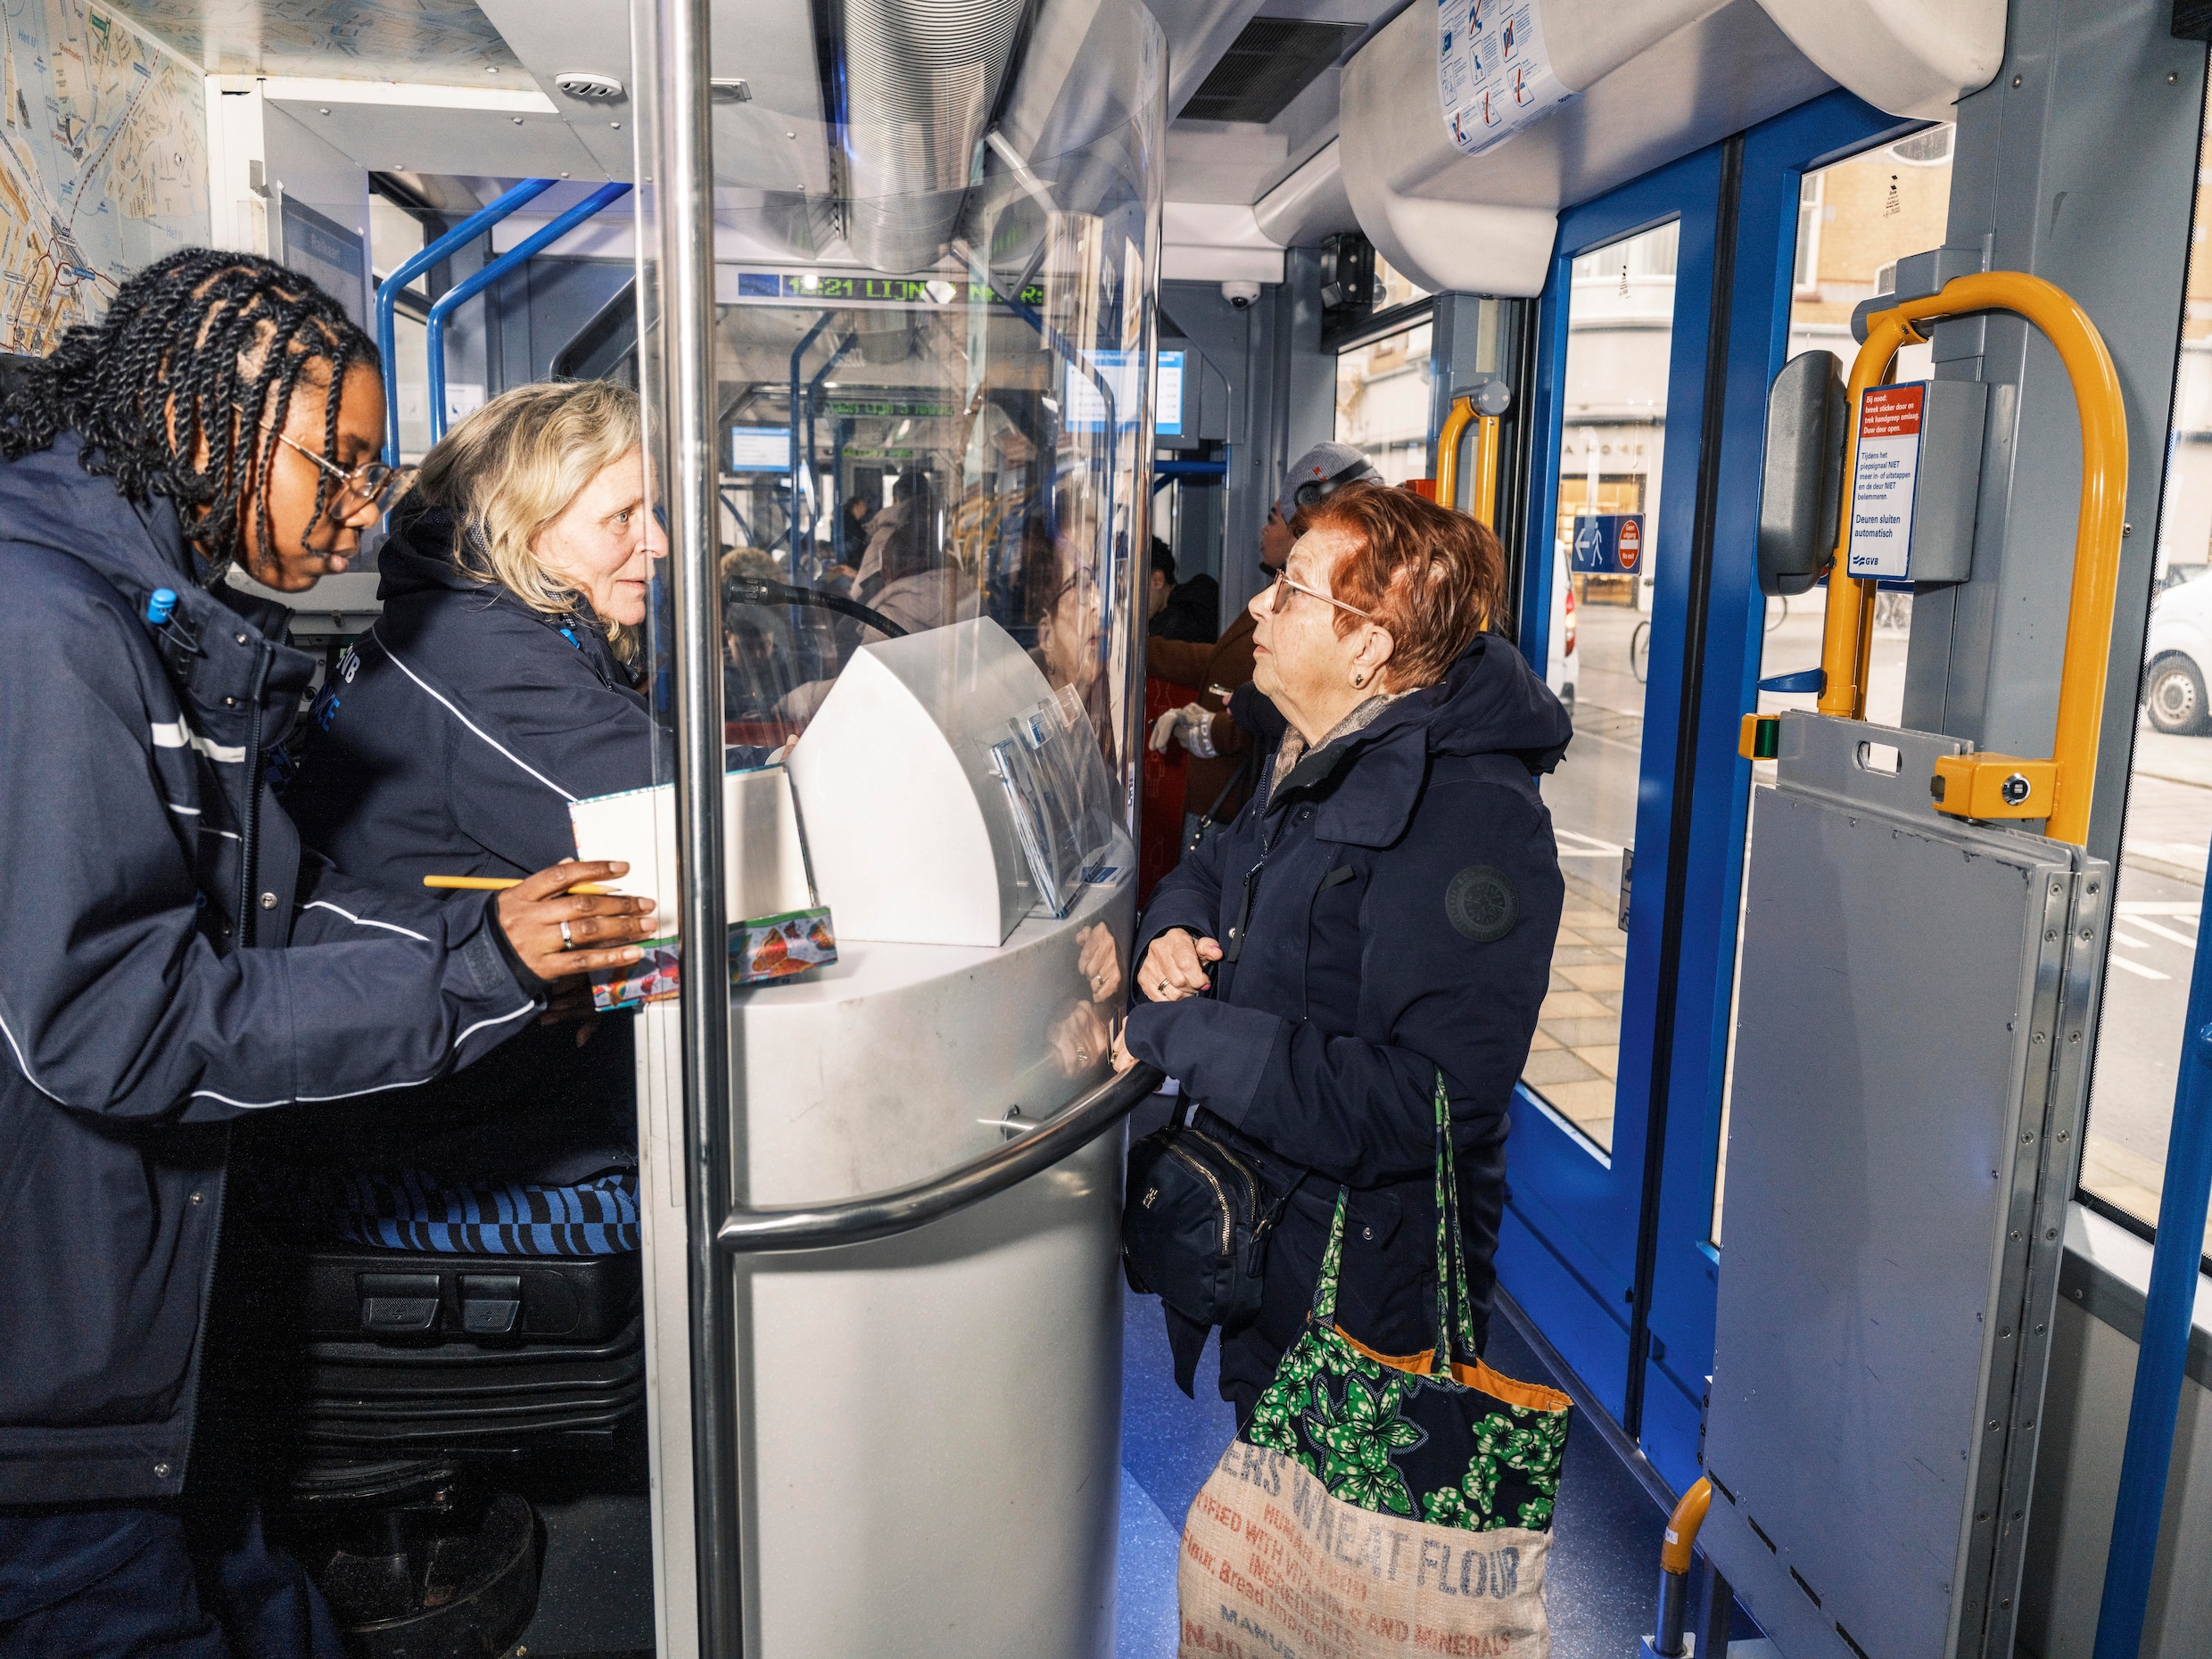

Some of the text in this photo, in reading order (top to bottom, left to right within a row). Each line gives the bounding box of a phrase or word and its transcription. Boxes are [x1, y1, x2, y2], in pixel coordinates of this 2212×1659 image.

[1865, 405, 1878, 413] breek
[1879, 404, 1895, 412] sticker
[1895, 402, 1907, 410] door
[1864, 416, 1874, 424] trek
[1875, 414, 1900, 424] handgreep
[1863, 426, 1875, 434] Duw
[1876, 425, 1886, 433] deur
[1861, 452, 1878, 460] Tijdens
[1860, 460, 1900, 471] piepsignaal NIET
[1886, 471, 1911, 480] uitstappen
[1873, 482, 1884, 490] deur
[1885, 482, 1896, 490] NIET
[1855, 514, 1901, 524] Deuren sluiten
[1854, 528, 1893, 538] automatisch
[1865, 557, 1879, 565] GVB
[1293, 1462, 1409, 1581] WHEAT
[1417, 1537, 1520, 1600] FLOUR
[1218, 1559, 1265, 1607] Bread
[1245, 1519, 1284, 1566] WITH
[1366, 1613, 1409, 1643] AND
[1414, 1623, 1512, 1658] MINERALS
